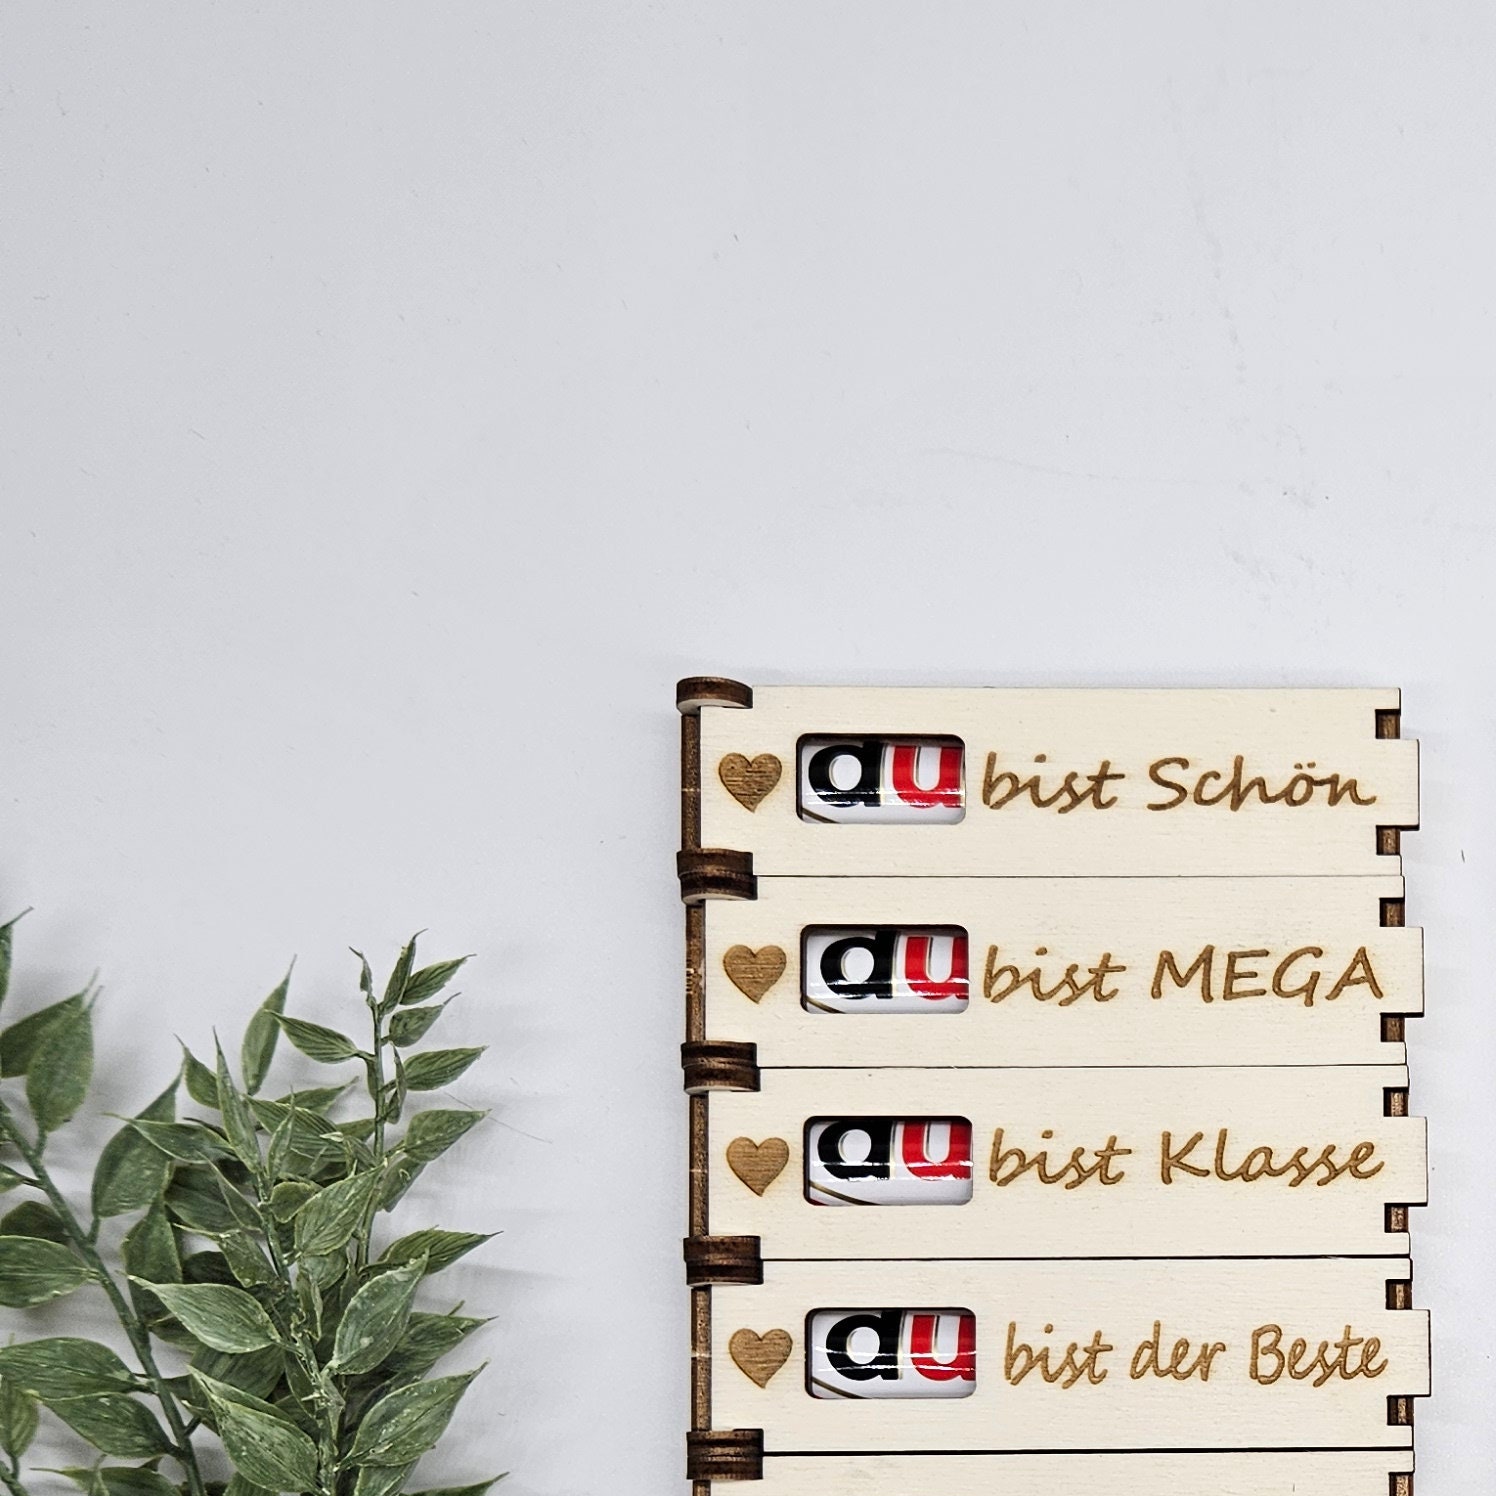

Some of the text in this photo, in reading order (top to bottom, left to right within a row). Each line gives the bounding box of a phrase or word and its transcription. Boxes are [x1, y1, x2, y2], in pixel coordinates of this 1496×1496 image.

[808, 742, 1378, 815] du bist Schön
[819, 931, 1385, 1008] du bist MEGA
[988, 1127, 1133, 1191] bist
[1160, 1127, 1386, 1188] Klasse
[825, 1311, 1389, 1390] du bist der Beste
